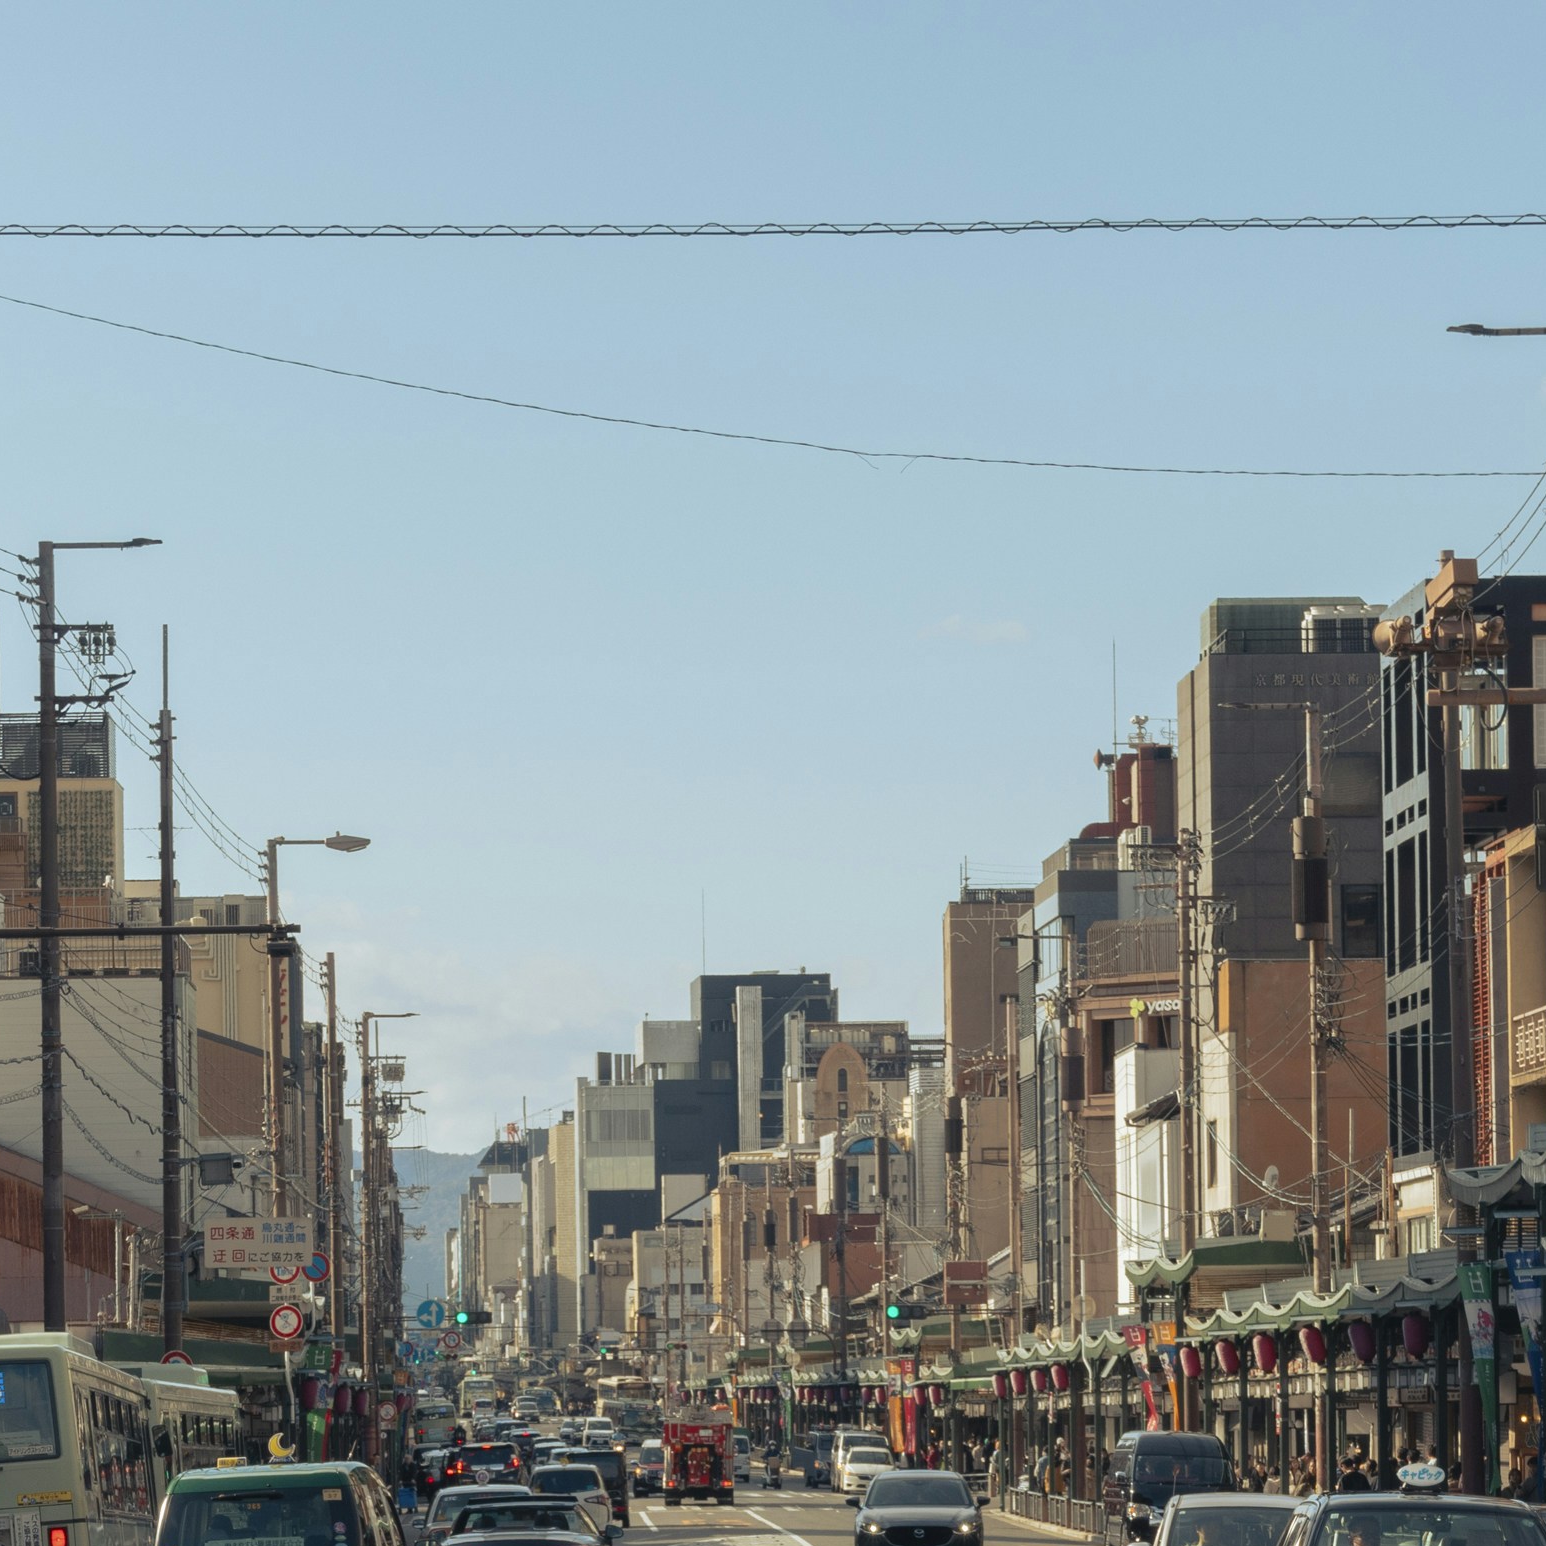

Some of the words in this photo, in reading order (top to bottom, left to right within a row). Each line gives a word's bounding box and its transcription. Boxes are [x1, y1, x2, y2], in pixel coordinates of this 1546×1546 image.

[1255, 672, 1379, 687] 京都現代美術館
[1146, 998, 1179, 1015] yasa
[210, 1226, 255, 1241] 四条通
[1401, 1467, 1443, 1480] キャピック
